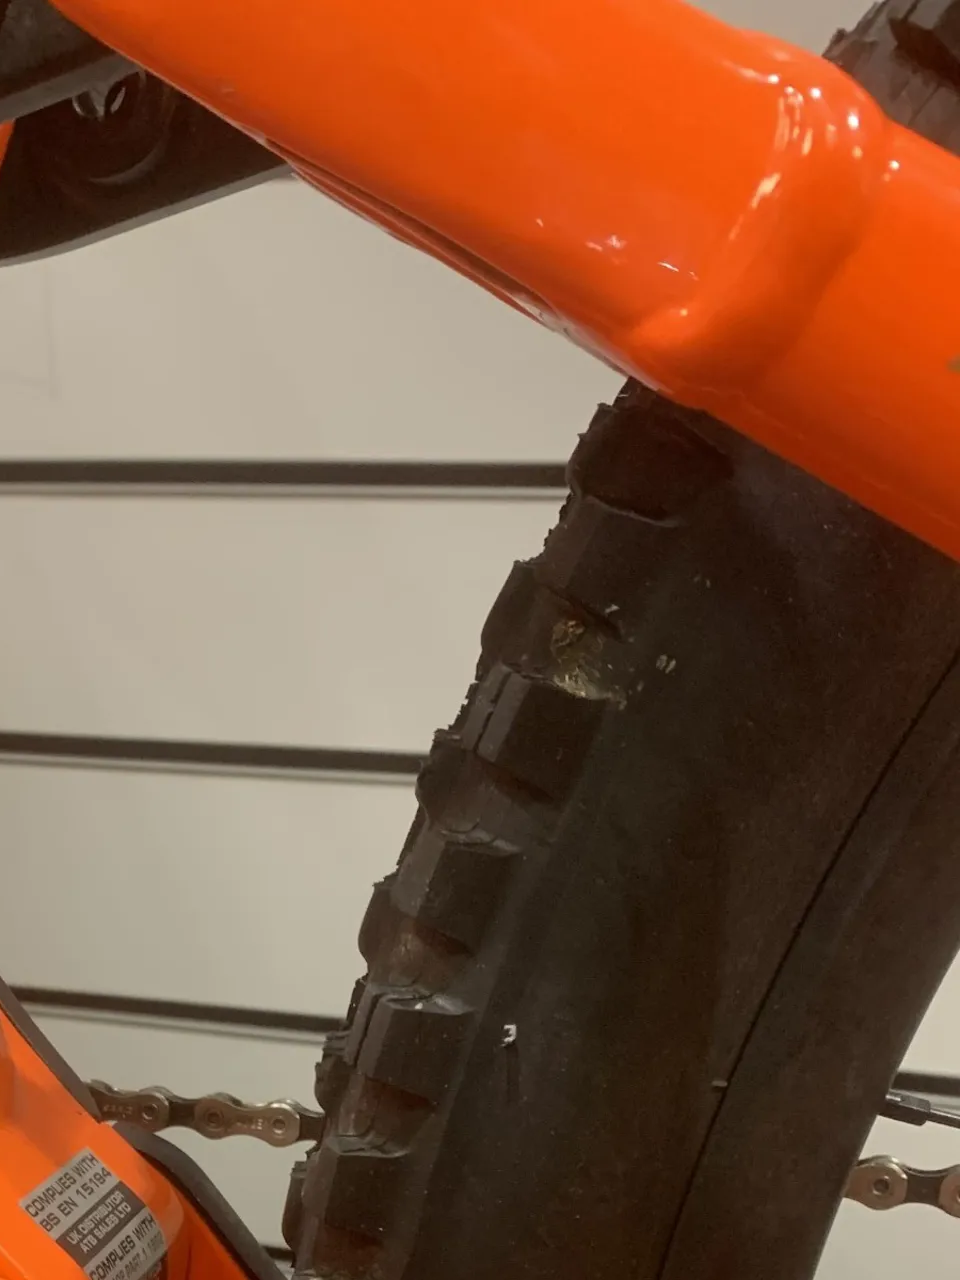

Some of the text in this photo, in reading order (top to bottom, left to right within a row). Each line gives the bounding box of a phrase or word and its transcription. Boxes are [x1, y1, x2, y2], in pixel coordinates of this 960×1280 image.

[25, 1152, 100, 1218] COMPLIES WITH
[40, 1166, 113, 1232] BS EN 15194
[79, 1190, 125, 1235] DISTRIBUTOR
[94, 1213, 119, 1239] SALES
[114, 1201, 132, 1218] LTD
[132, 1212, 157, 1241] WITH
